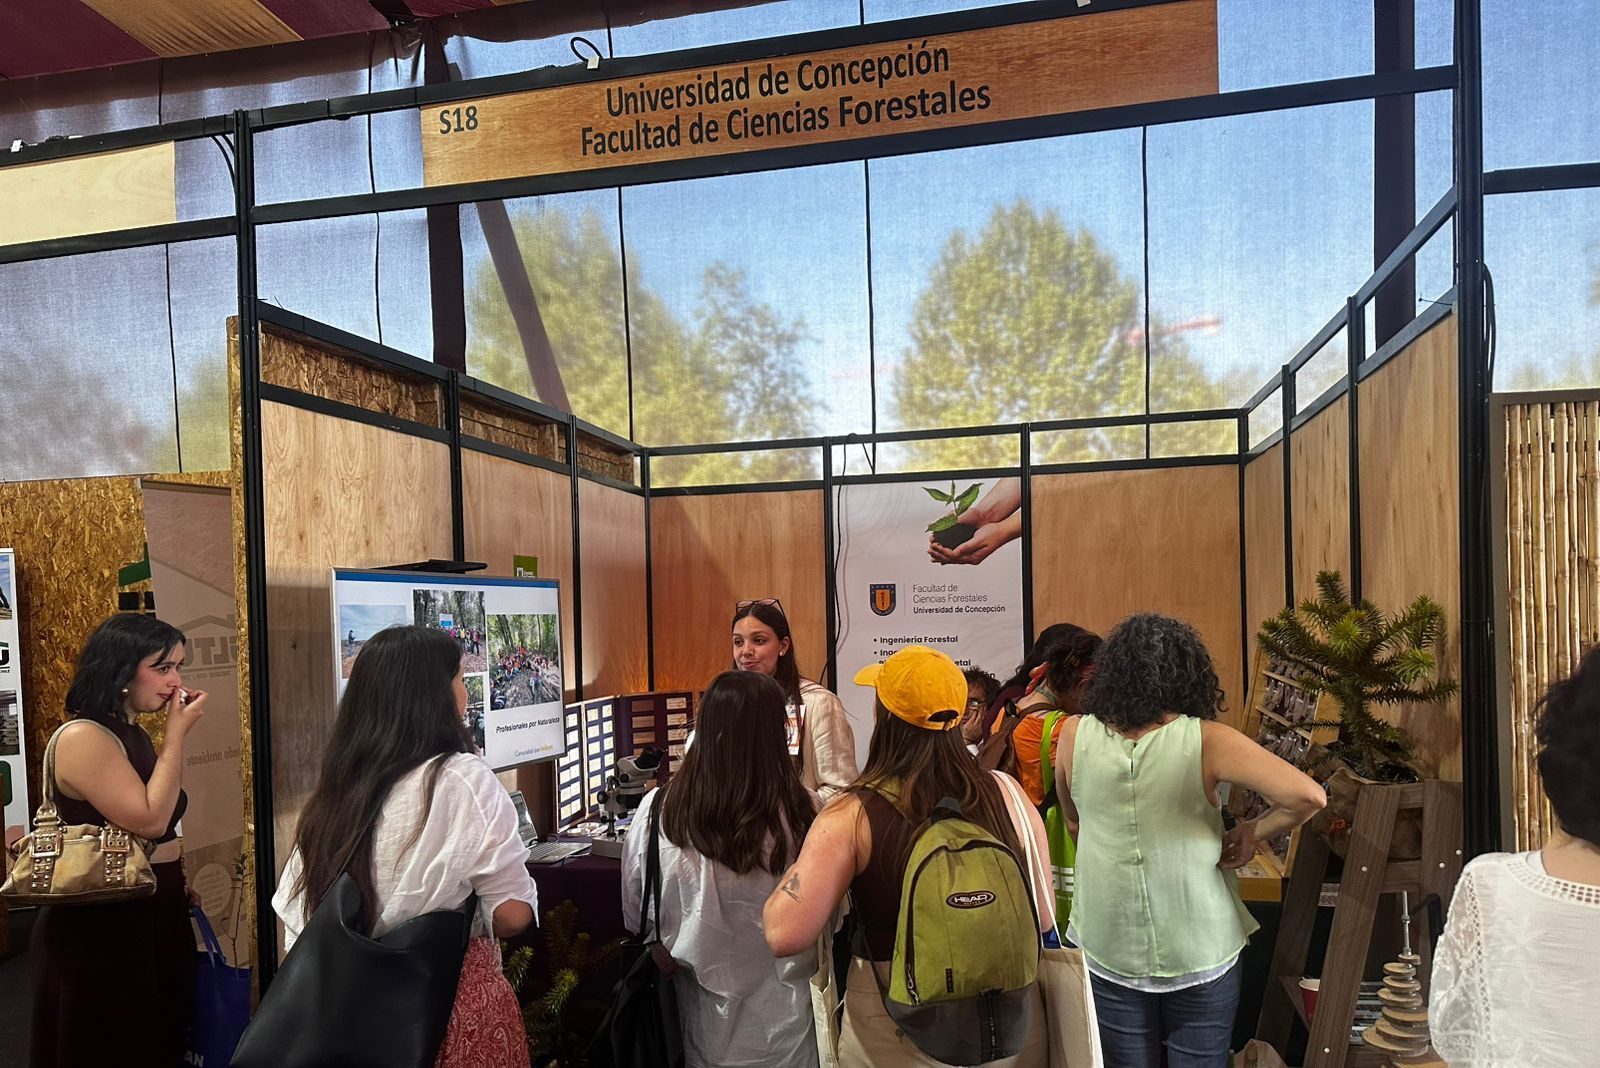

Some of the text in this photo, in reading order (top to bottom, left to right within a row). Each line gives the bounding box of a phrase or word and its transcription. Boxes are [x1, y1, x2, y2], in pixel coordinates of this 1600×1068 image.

[606, 40, 949, 117] Universidad de Concepción
[439, 105, 478, 135] S18
[581, 80, 991, 156] Facultad de Ciencias Forestales
[912, 583, 958, 593] Facultad de
[912, 593, 988, 604] Ciencias Forestales
[913, 604, 1006, 614] Universidad de Concepción
[880, 635, 959, 645] Ingeniería Forestal
[496, 717, 560, 733] Profesionales por Naturaleza
[954, 894, 988, 903] HEAD
